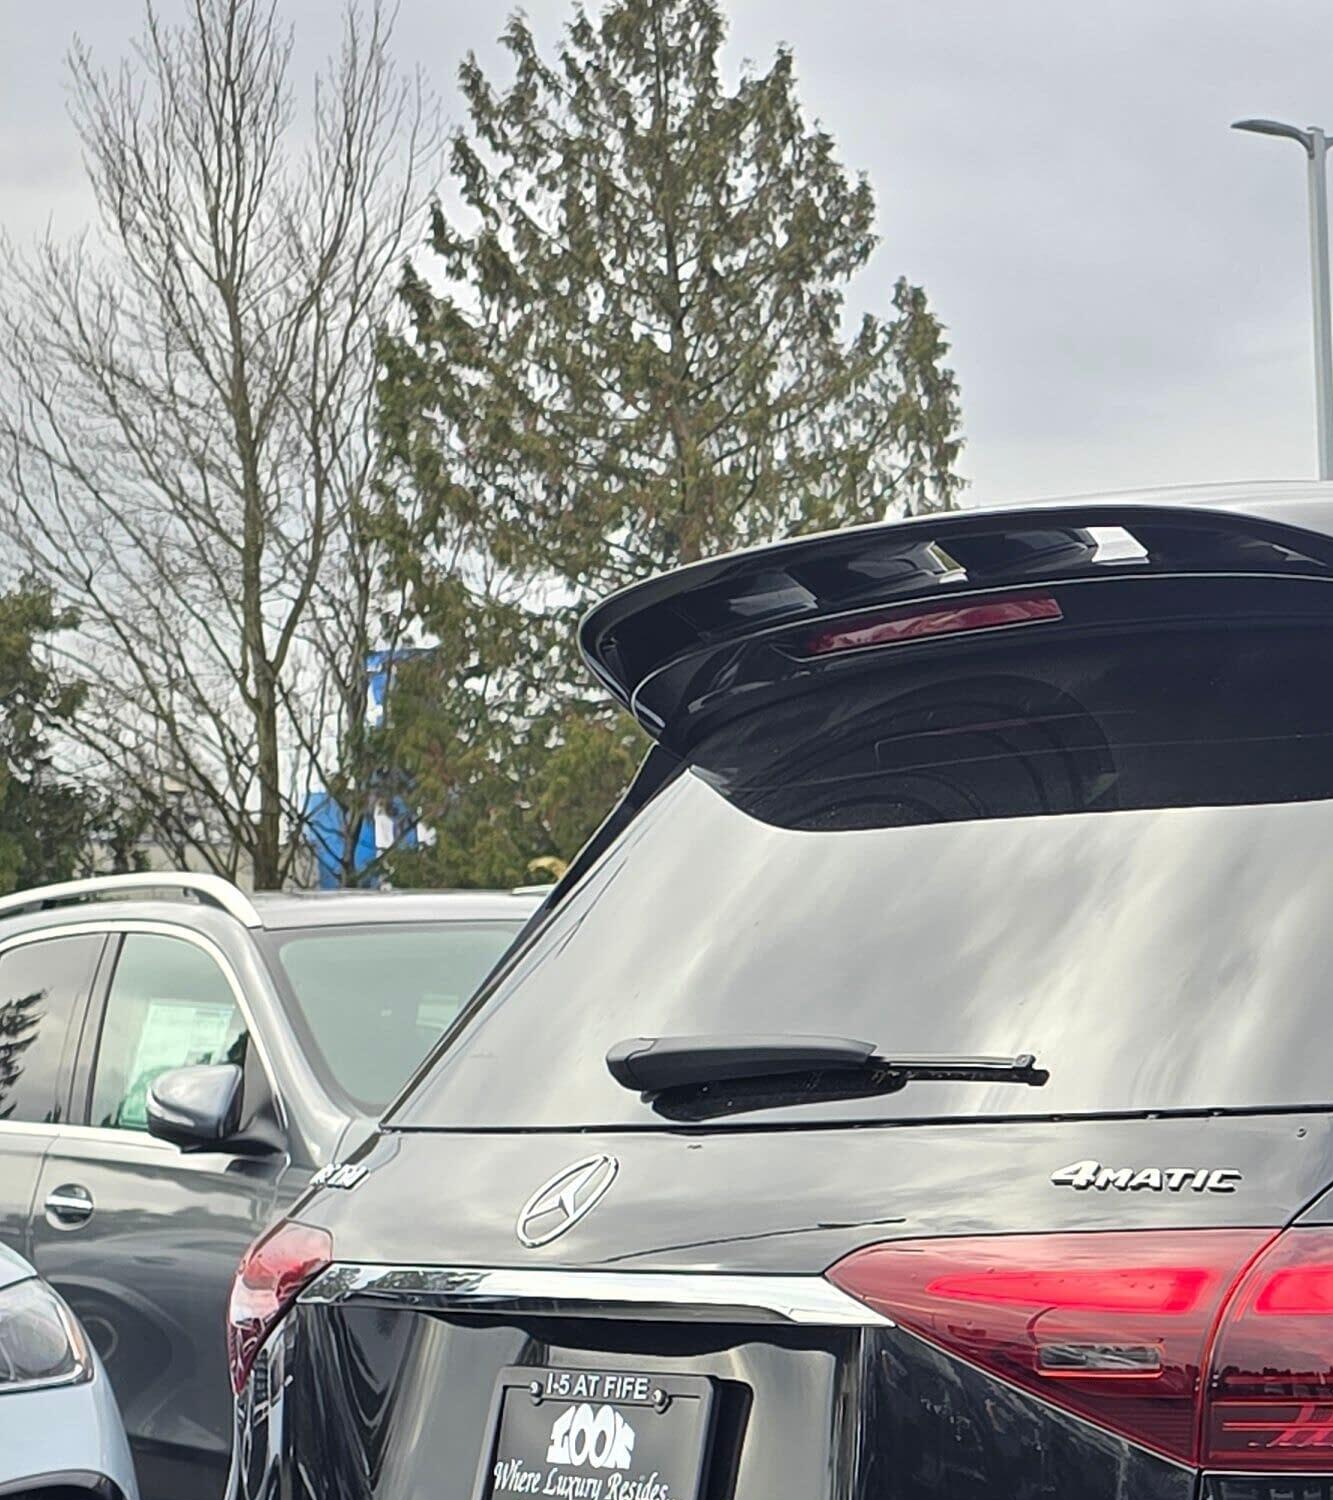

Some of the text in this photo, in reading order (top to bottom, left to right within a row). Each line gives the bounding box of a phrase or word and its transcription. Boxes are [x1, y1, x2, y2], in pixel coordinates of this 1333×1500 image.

[1050, 1160, 1242, 1192] 4MATIC
[546, 1373, 648, 1400] I-5 AT FIFE
[493, 1459, 540, 1494] Where
